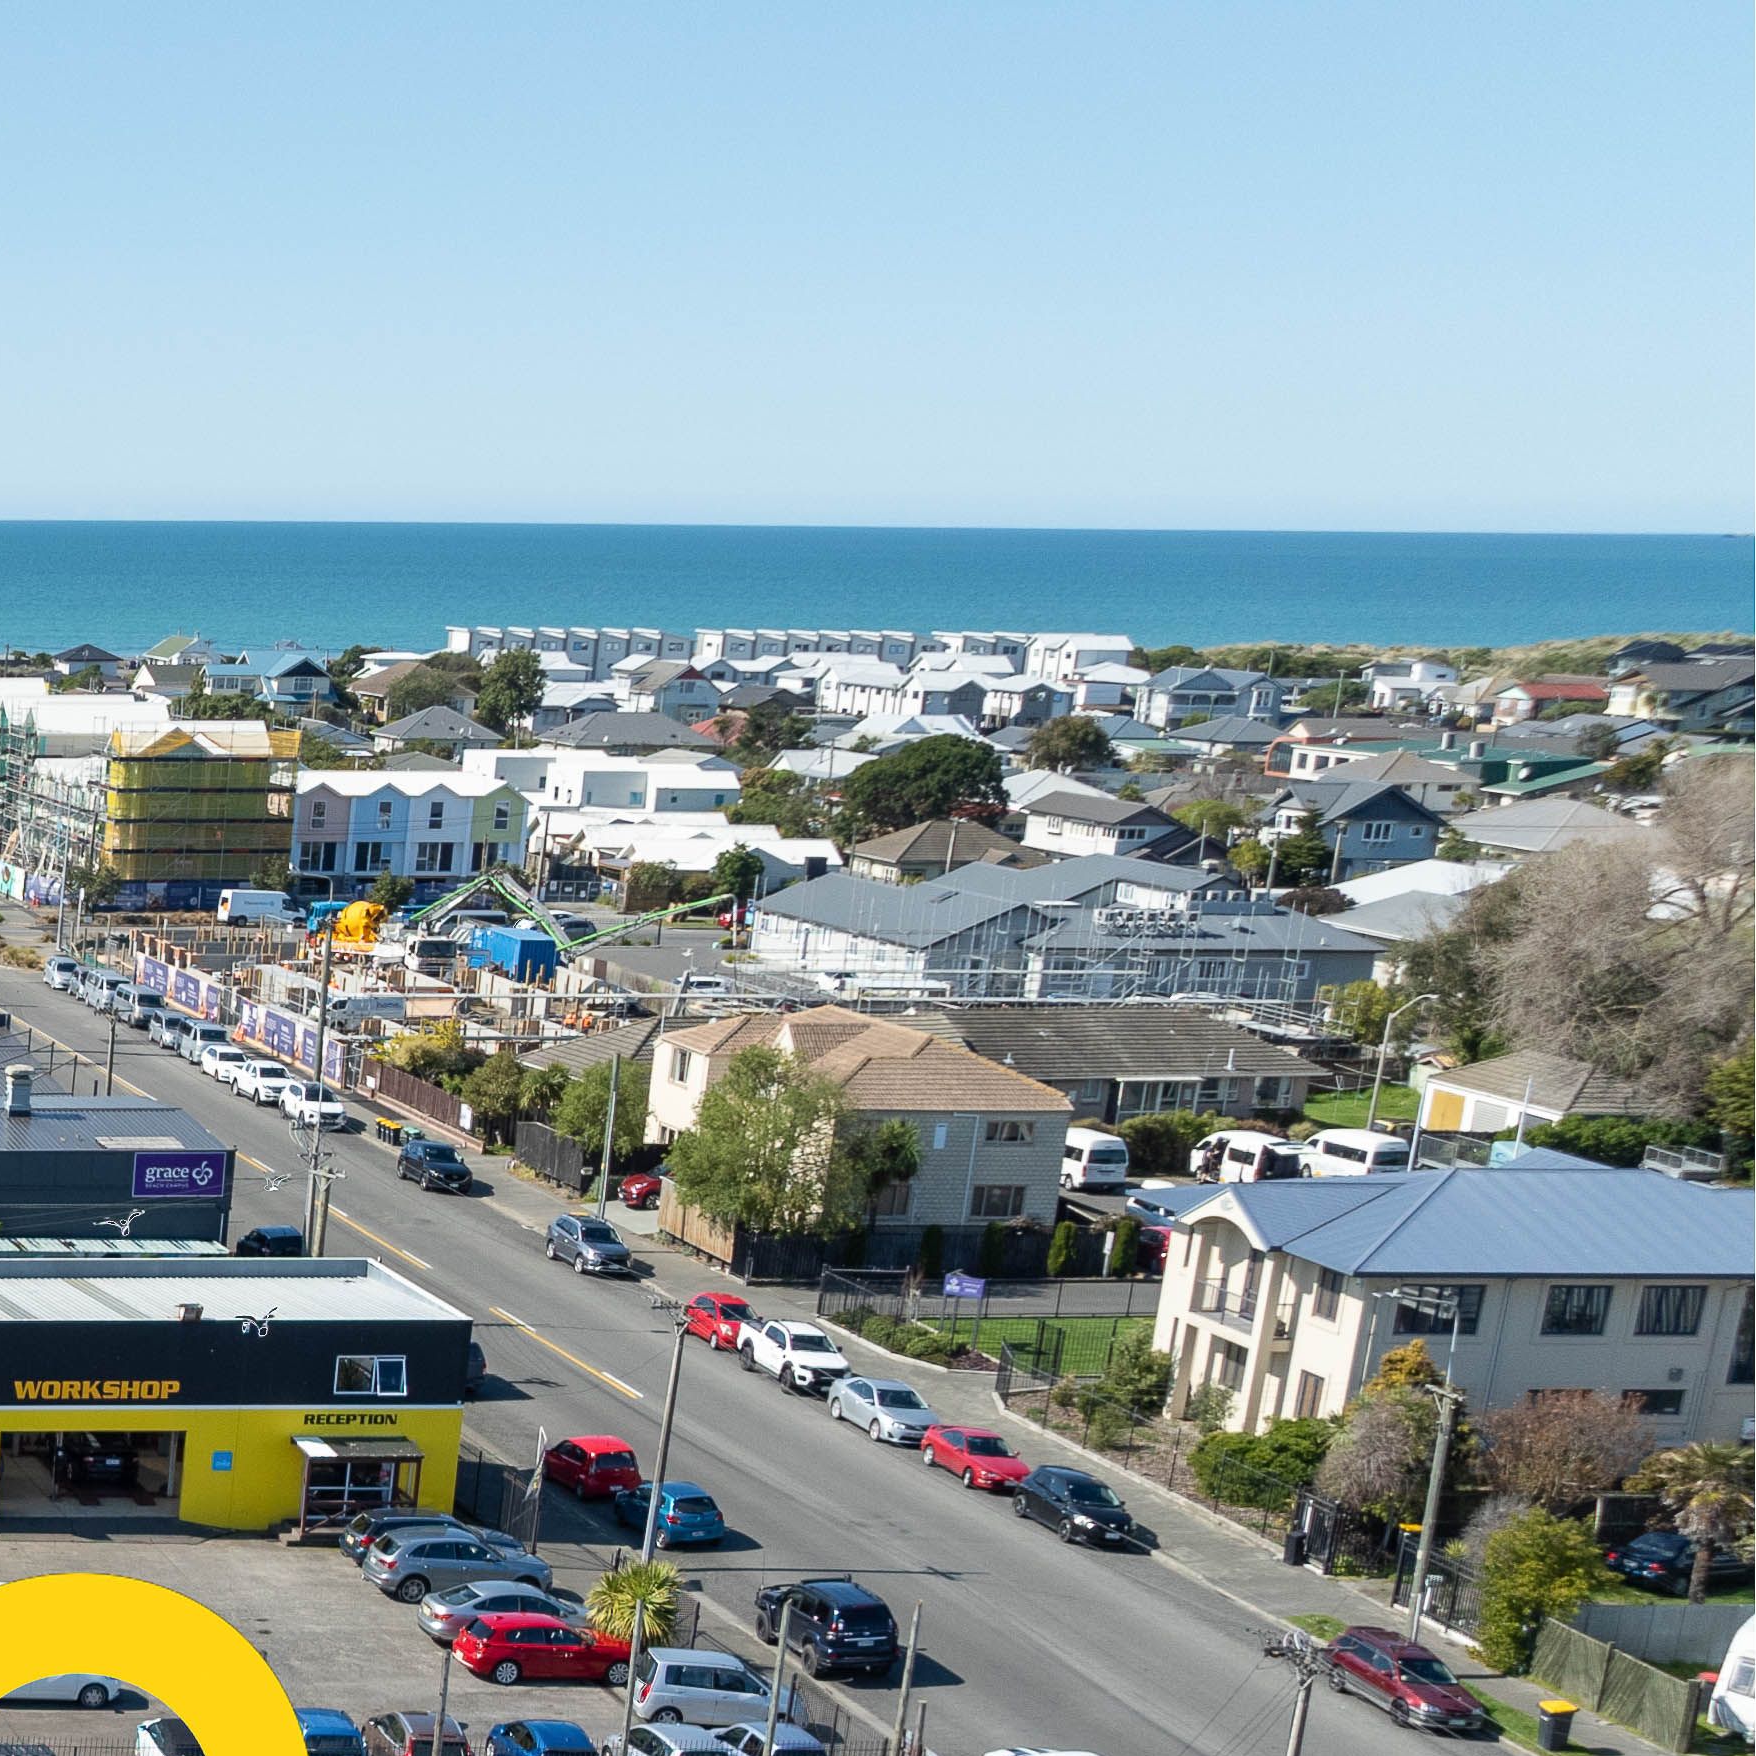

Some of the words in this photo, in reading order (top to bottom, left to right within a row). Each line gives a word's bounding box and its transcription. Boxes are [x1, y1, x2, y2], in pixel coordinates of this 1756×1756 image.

[145, 1166, 189, 1183] grace
[14, 1380, 180, 1399] WORKSHOP
[303, 1413, 397, 1425] RECEPTION
